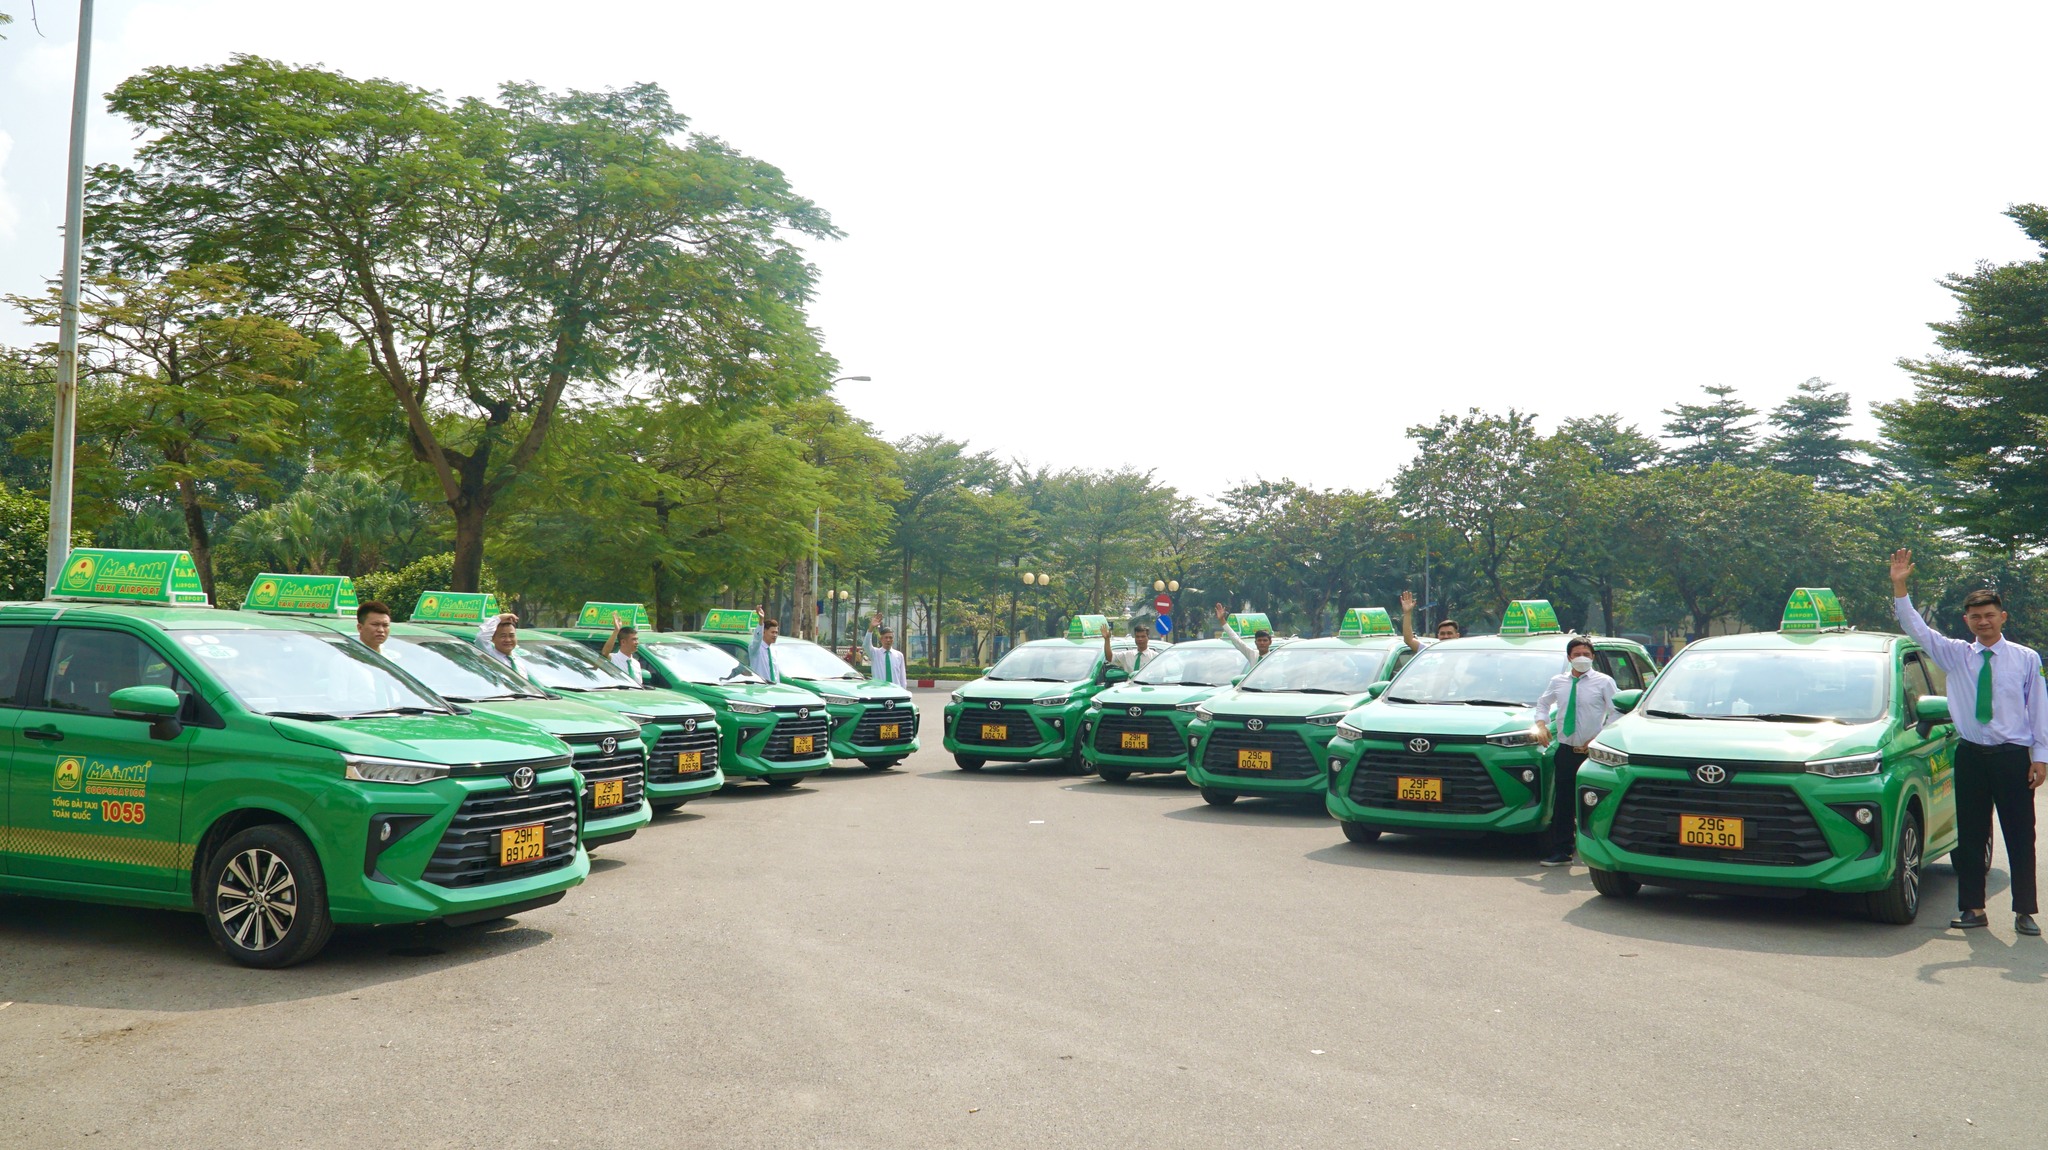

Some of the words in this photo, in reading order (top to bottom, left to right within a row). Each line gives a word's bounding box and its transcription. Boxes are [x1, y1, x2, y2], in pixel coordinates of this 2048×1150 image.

[175, 567, 196, 578] TAXI
[95, 583, 116, 593] TAXI
[118, 585, 161, 596] AIRPORT
[278, 600, 295, 608] TAXI
[297, 601, 330, 610] AIRPORT
[1790, 601, 1812, 609] TAXI
[1129, 733, 1141, 741] 29H
[1124, 740, 1146, 749] 891.15
[1247, 751, 1263, 760] 29G
[1241, 760, 1269, 769] 004.70
[603, 782, 615, 793] 29F
[1410, 778, 1429, 789] 29F
[85, 785, 146, 797] CORPORATION
[1402, 789, 1437, 800] 055.82
[597, 793, 620, 806] 055.72
[84, 801, 98, 810] TAXI
[52, 808, 70, 819] TOÀN
[72, 809, 91, 821] QUỐC
[101, 799, 146, 825] 1055
[1698, 817, 1725, 831] 29G
[514, 828, 533, 844] 29H
[1687, 831, 1736, 847] 003.90
[506, 843, 540, 862] 891.22
